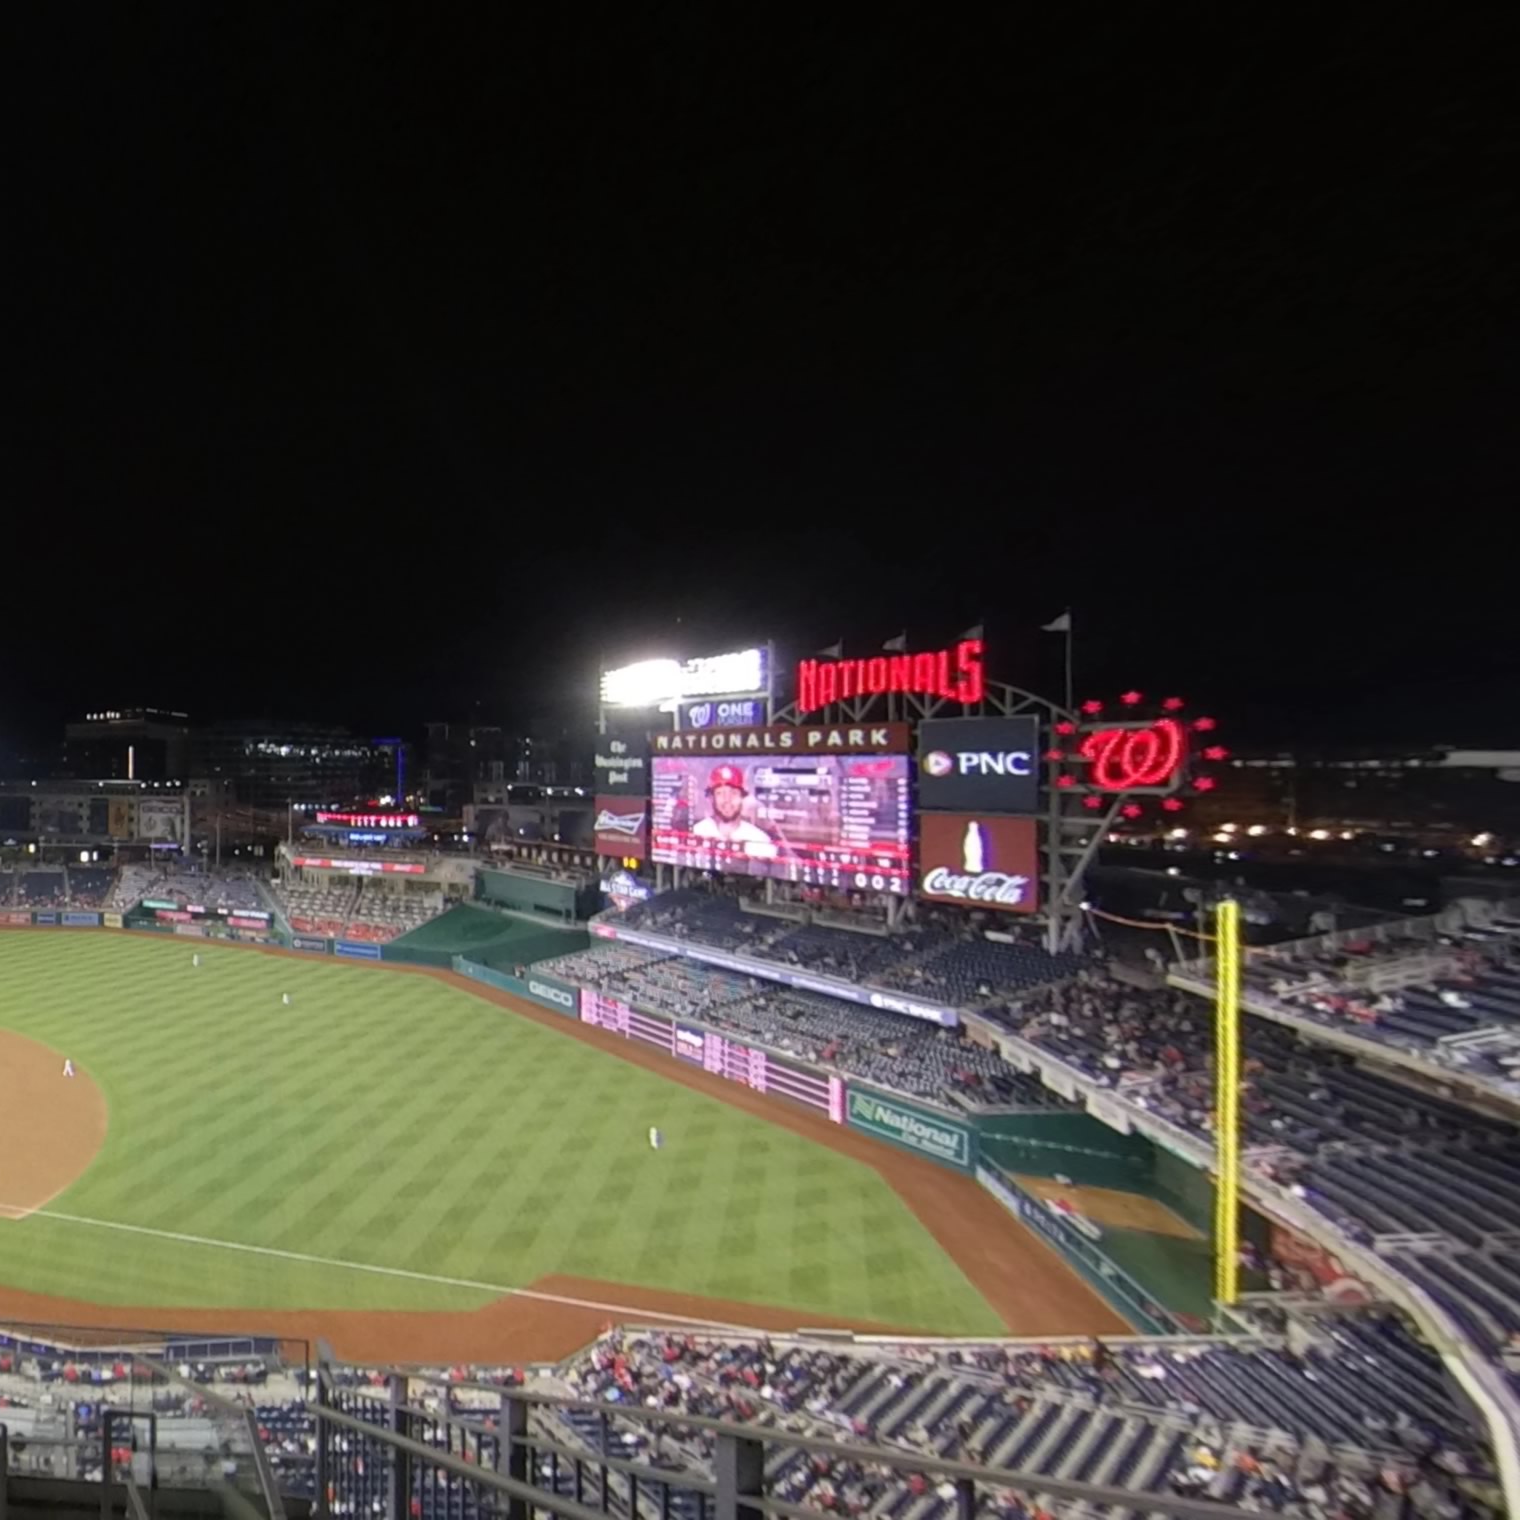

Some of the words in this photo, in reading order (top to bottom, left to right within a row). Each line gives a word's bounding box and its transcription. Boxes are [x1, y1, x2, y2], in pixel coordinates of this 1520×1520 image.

[798, 640, 984, 712] NATIONALS
[718, 702, 754, 716] ONE
[657, 732, 793, 750] NATIONALS
[808, 728, 889, 746] PARK
[958, 751, 1030, 775] PNC
[889, 877, 902, 892] 2
[529, 981, 573, 1007] GEICO
[875, 1106, 959, 1148] National
